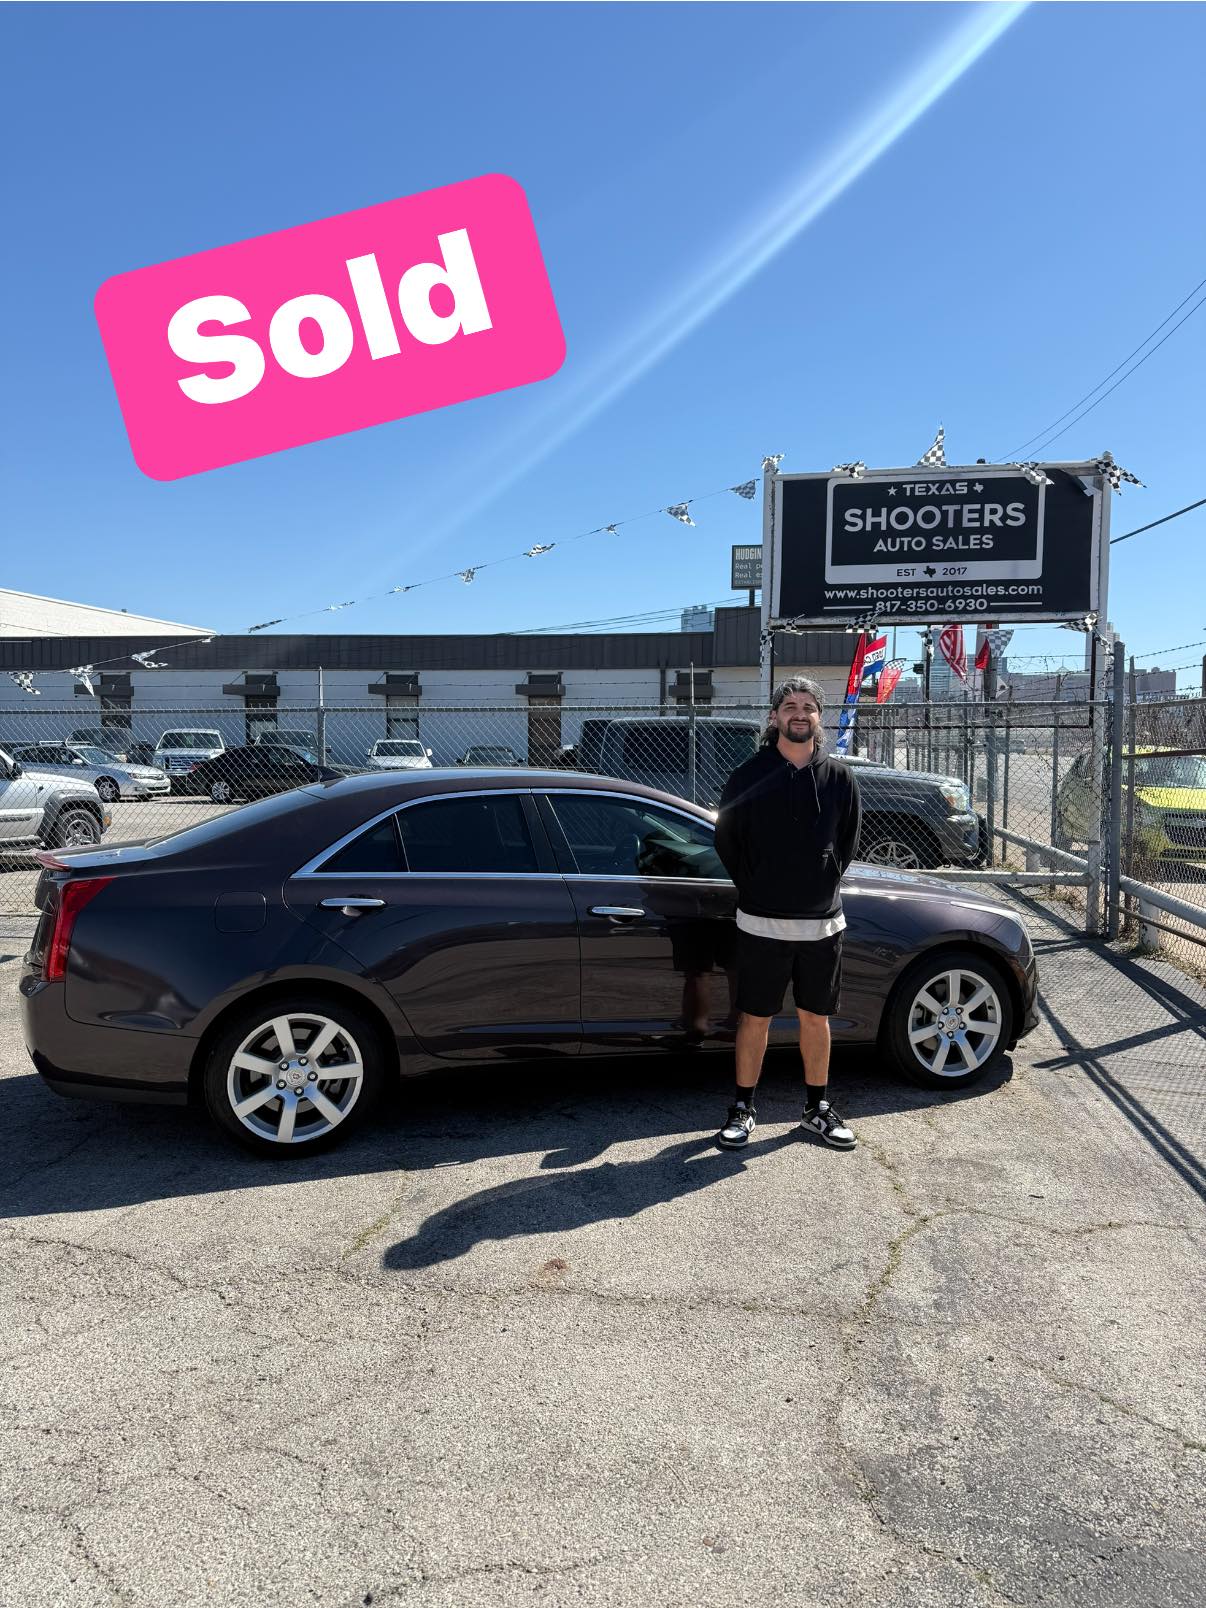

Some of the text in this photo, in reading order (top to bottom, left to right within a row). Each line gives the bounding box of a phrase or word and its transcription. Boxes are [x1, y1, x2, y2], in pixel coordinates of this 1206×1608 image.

[903, 482, 968, 496] TEXAS
[844, 503, 1026, 532] SHOOTERS
[873, 535, 994, 552] AUTO SALES
[735, 562, 752, 570] Real
[896, 567, 968, 577] EST 2017
[735, 571, 752, 579] Real
[824, 584, 1043, 599] www.shootersautosales.com
[875, 599, 988, 612] 817-350-6930
